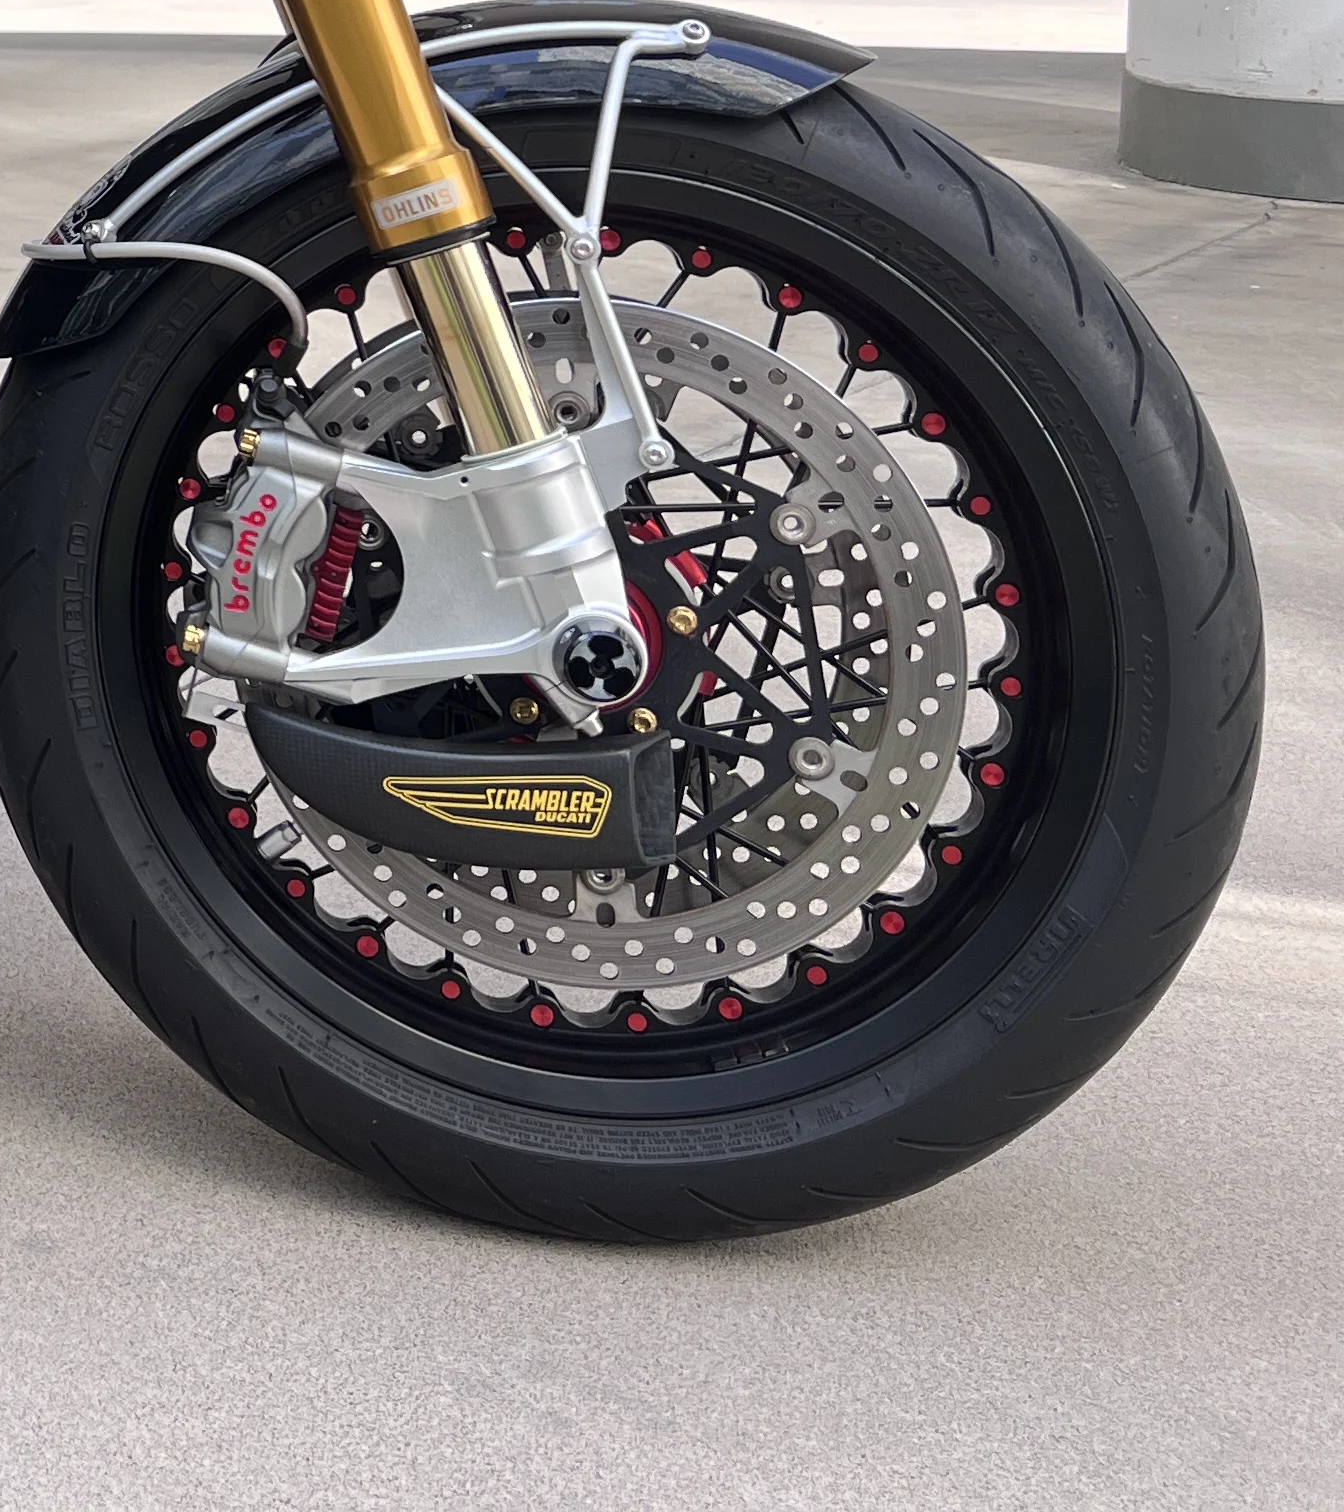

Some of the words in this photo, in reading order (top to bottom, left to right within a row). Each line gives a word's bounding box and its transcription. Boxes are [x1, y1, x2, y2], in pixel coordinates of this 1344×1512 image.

[224, 493, 278, 614] brembo
[62, 522, 100, 730] DIABLO
[485, 788, 596, 813] SCRAMBLER
[535, 811, 592, 824] DUCATI
